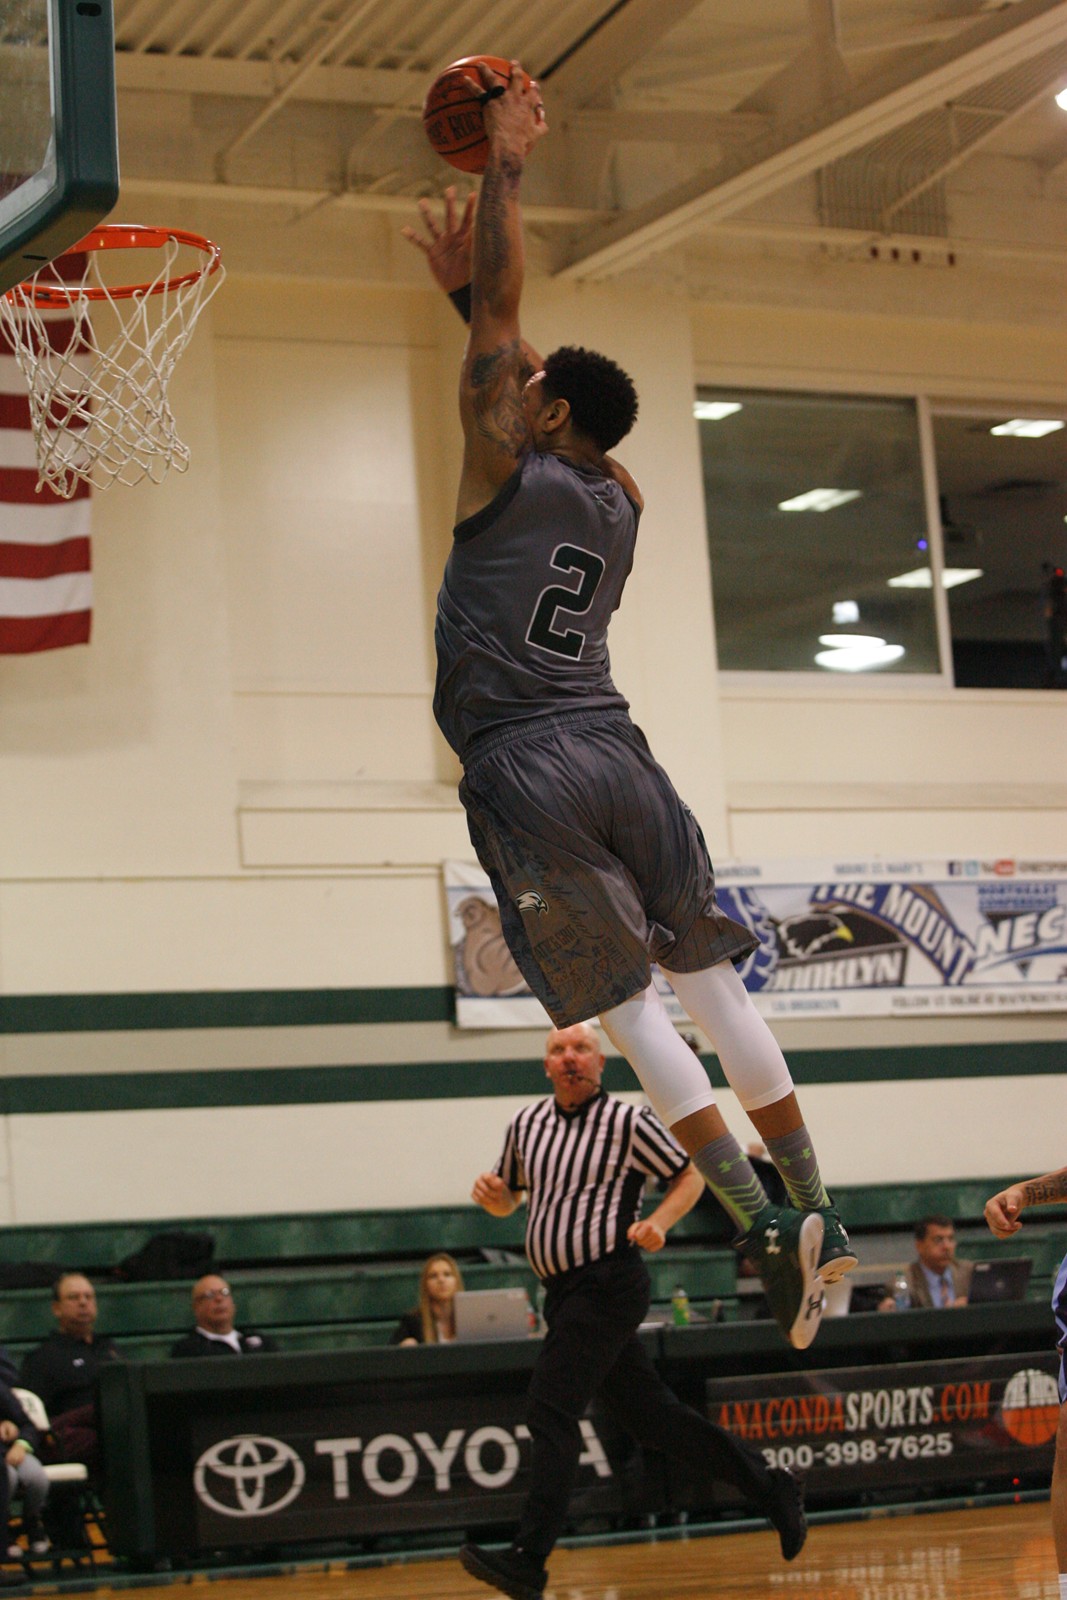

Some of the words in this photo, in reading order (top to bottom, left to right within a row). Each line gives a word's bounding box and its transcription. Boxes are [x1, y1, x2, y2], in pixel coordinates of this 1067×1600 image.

[525, 543, 606, 661] 2
[880, 884, 976, 986] MOUNT
[717, 1382, 992, 1439] ANACONDASPORTS.COM
[315, 1420, 613, 1498] TOYOA
